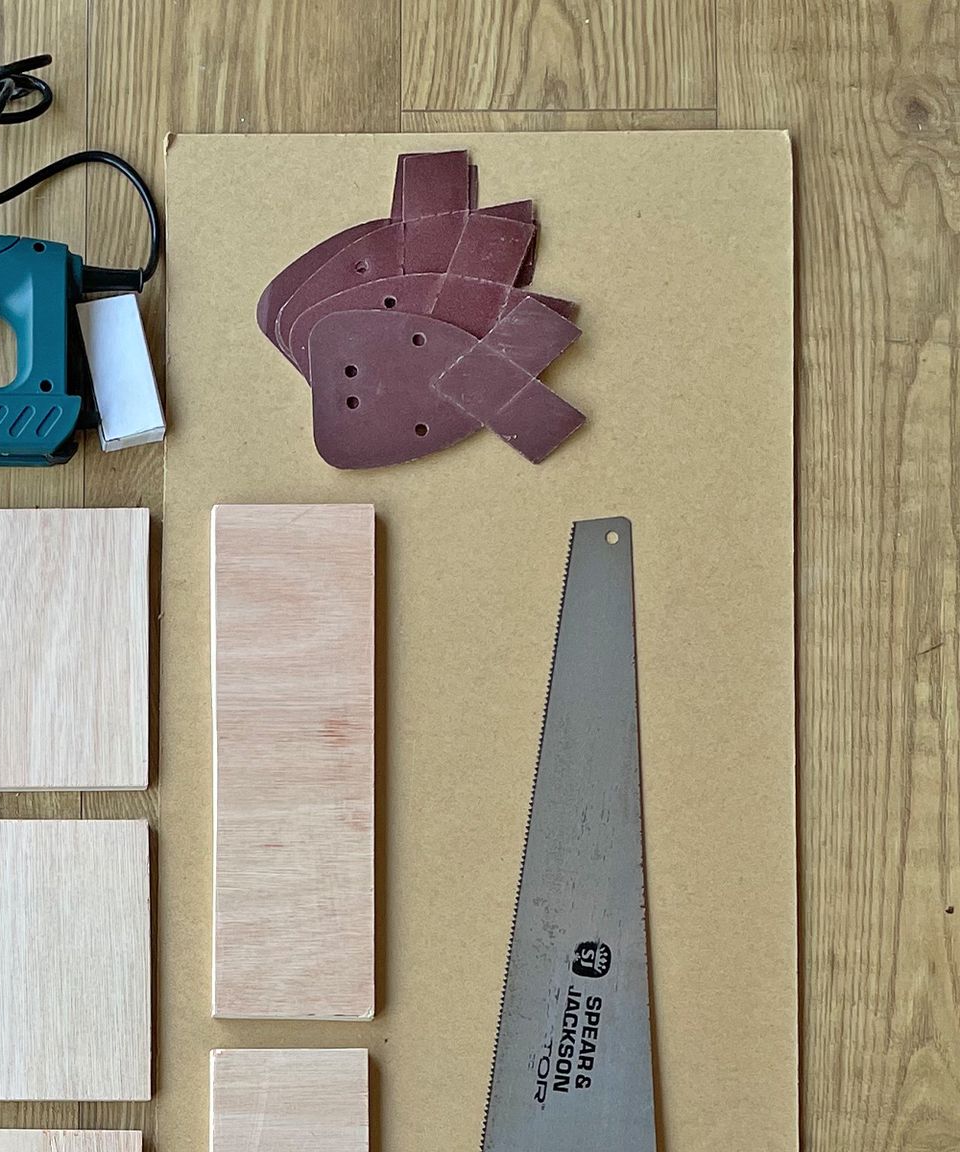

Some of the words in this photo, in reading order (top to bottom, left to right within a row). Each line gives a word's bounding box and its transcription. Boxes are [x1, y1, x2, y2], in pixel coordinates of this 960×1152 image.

[552, 985, 582, 1093] JACKSON
[577, 996, 602, 1071] SPEAR
[575, 1074, 592, 1089] &
